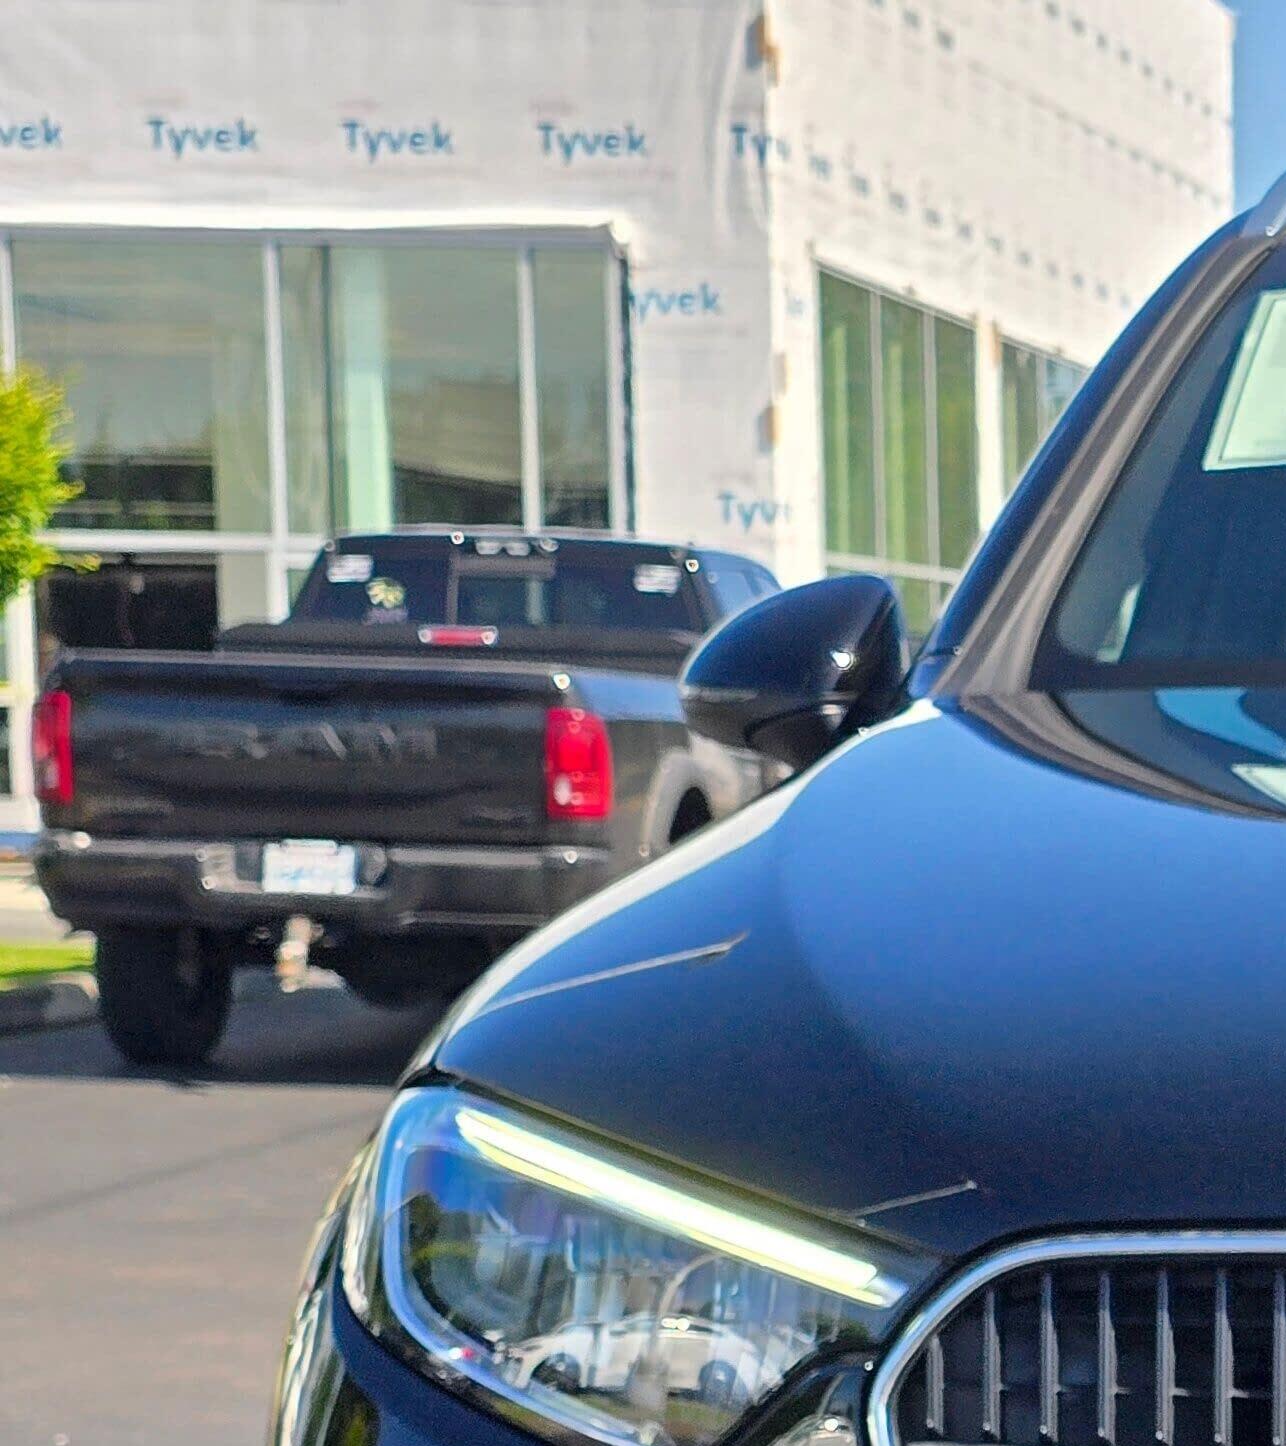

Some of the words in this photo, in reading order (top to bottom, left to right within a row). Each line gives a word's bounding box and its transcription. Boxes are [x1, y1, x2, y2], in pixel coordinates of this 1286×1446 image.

[146, 115, 260, 160] Tyvek
[340, 117, 454, 163] Tyvek
[535, 119, 649, 166] Tyvek
[629, 282, 722, 325] yvek
